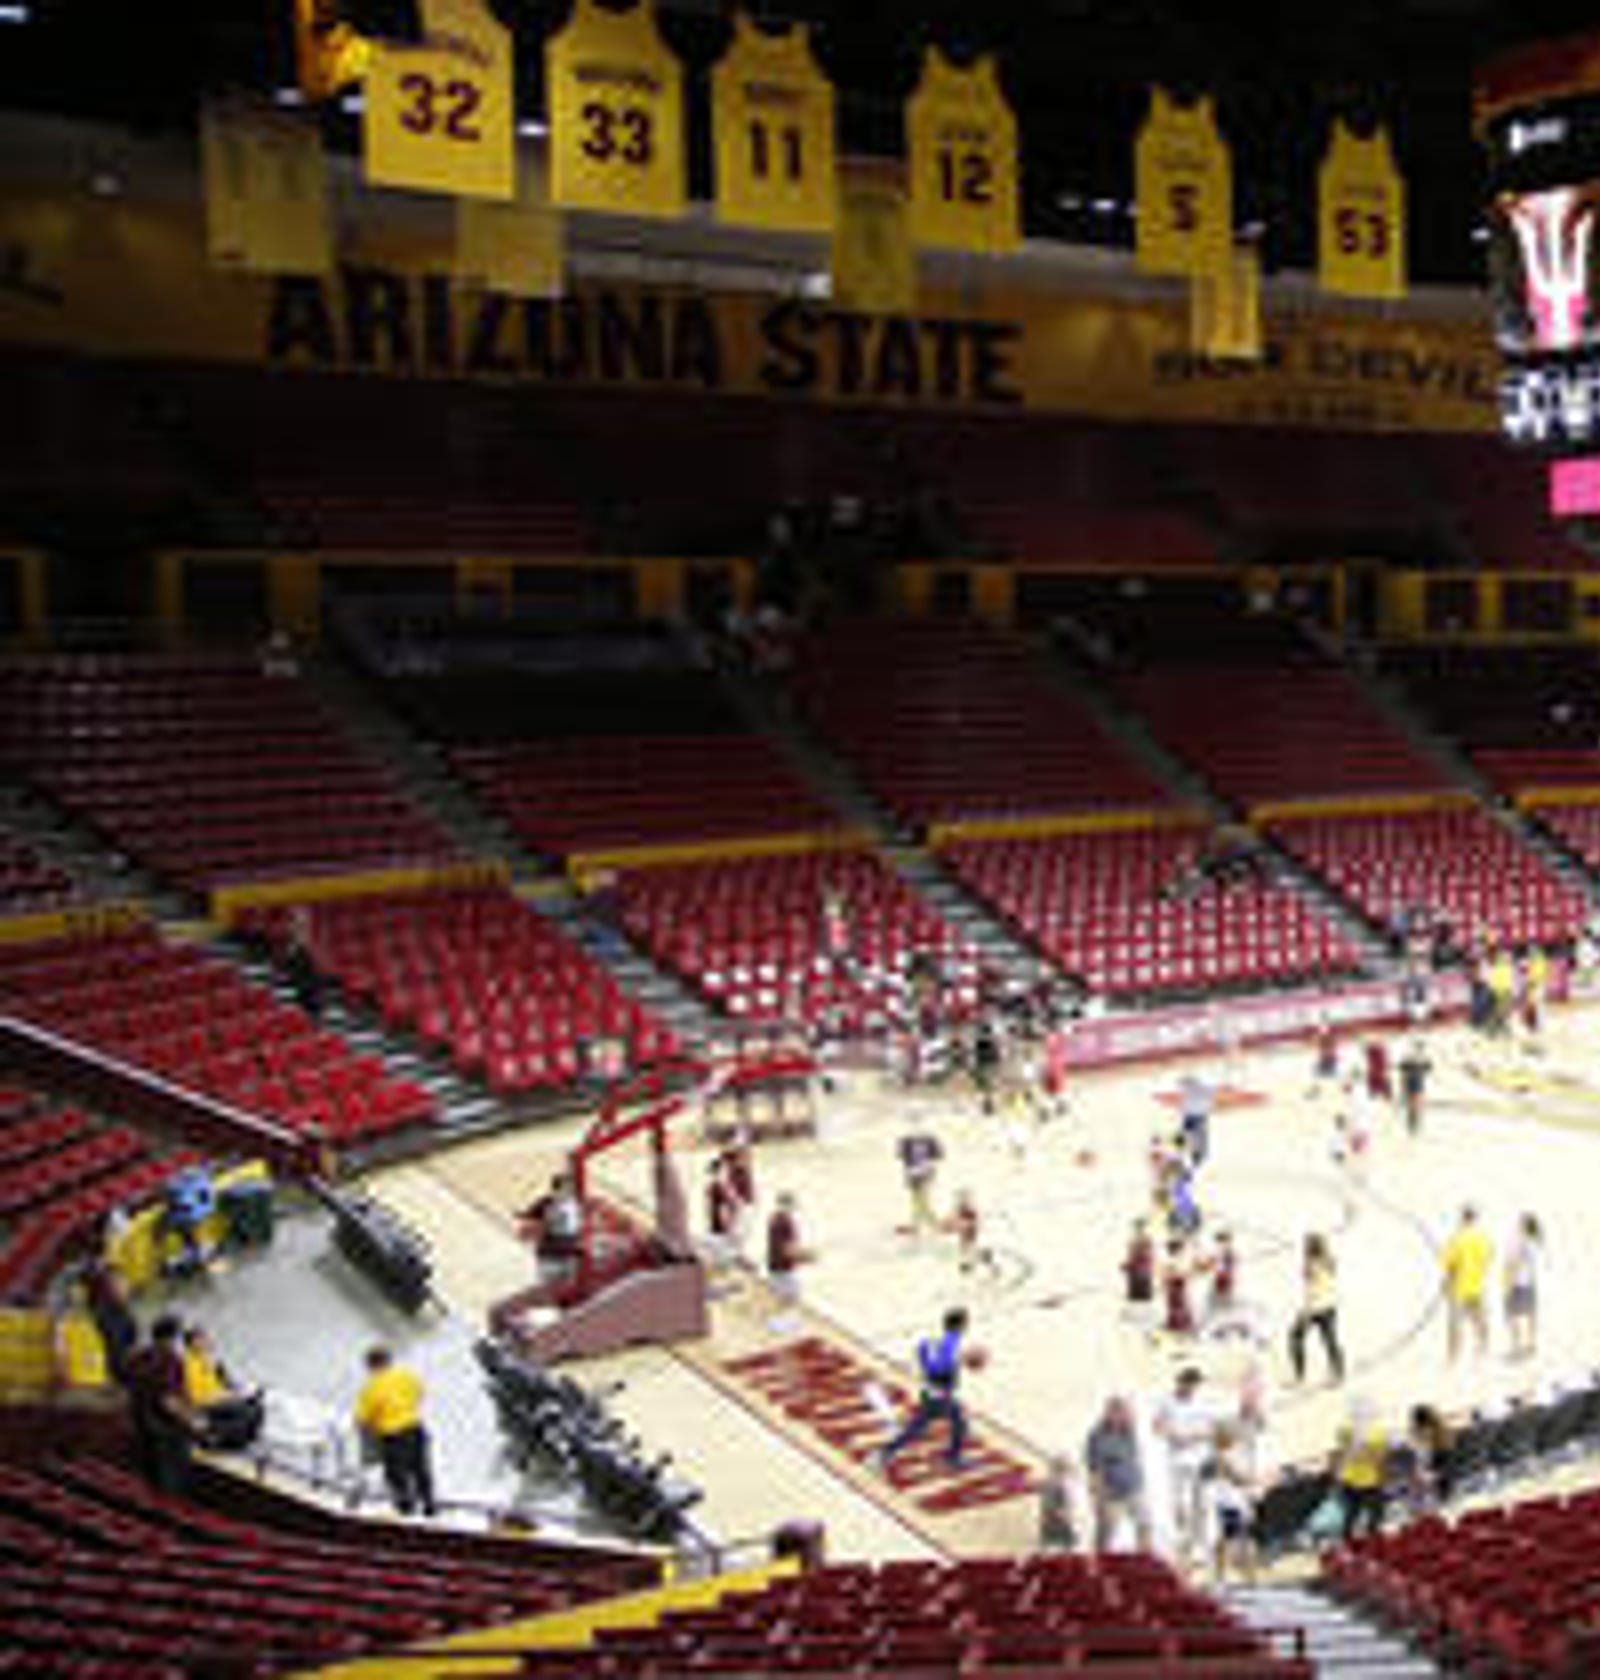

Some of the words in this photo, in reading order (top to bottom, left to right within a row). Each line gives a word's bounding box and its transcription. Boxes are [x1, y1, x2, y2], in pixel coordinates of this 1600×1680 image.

[400, 75, 480, 141] 32
[581, 105, 651, 165] 33
[751, 121, 802, 180] 11
[936, 152, 993, 202] 12
[1168, 184, 1199, 231] 5
[266, 266, 714, 386] ARIZONA
[762, 304, 1022, 402] STATE
